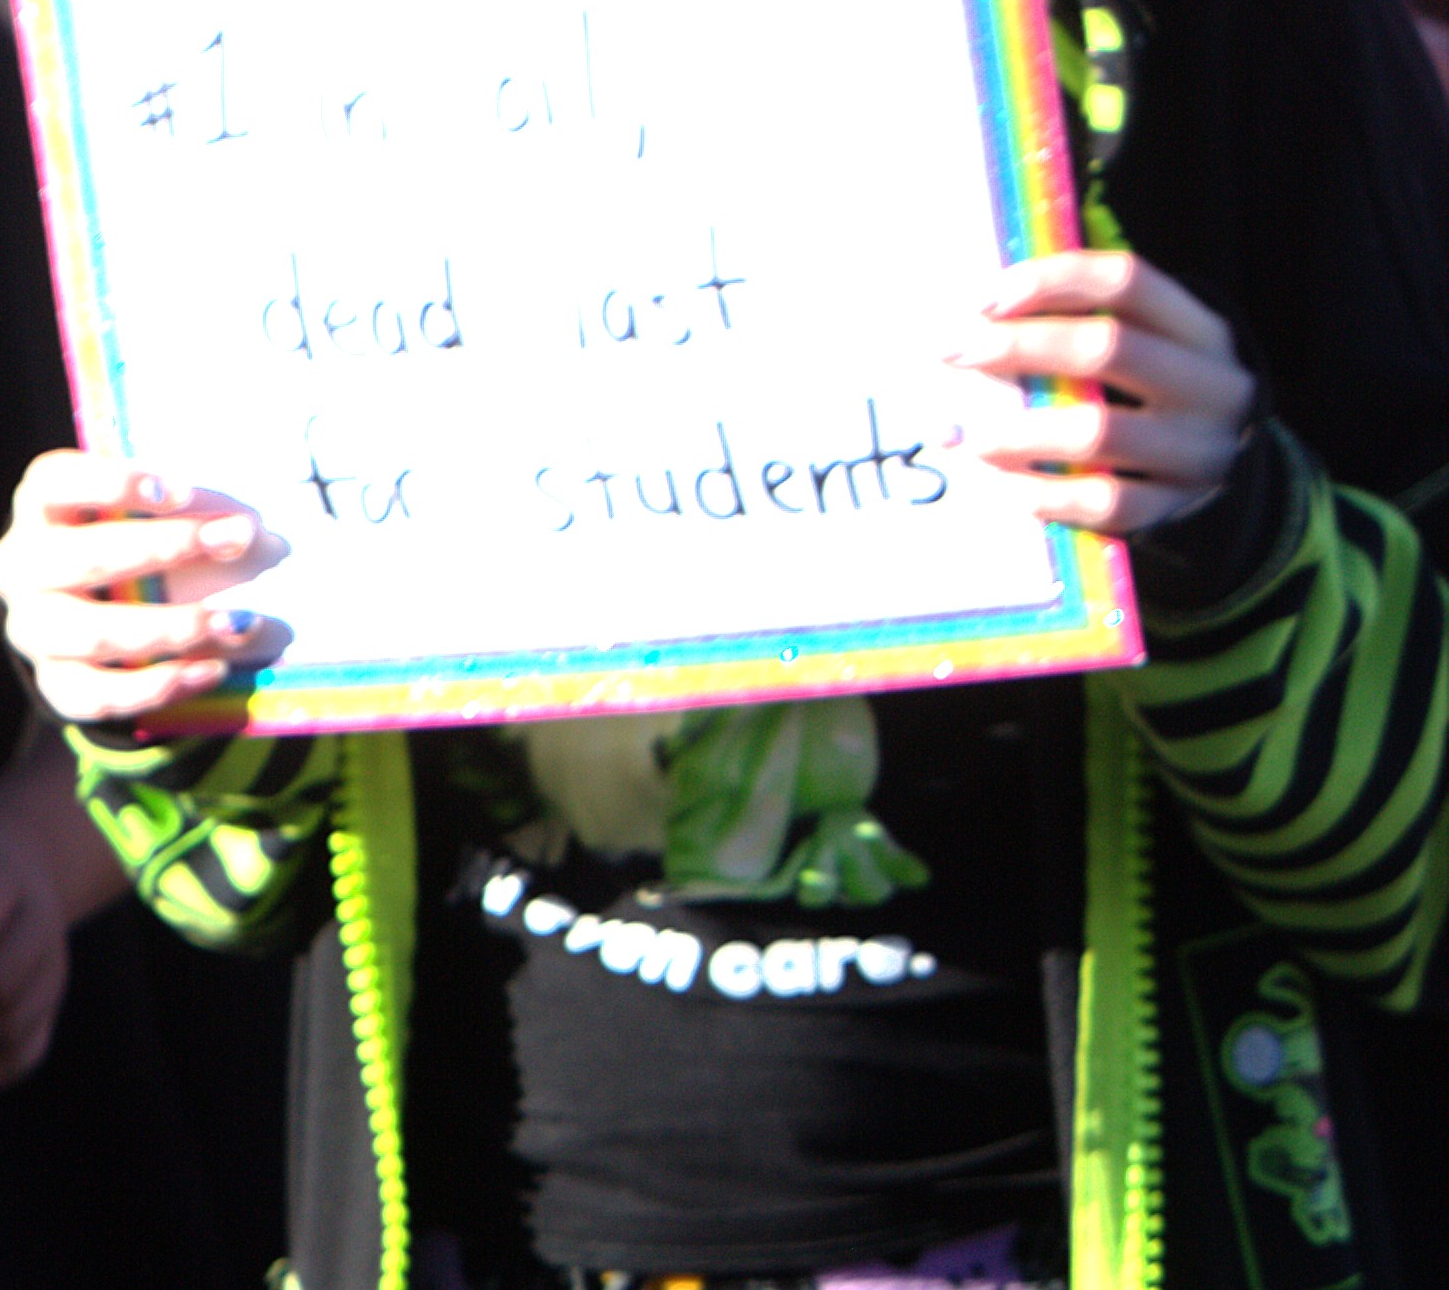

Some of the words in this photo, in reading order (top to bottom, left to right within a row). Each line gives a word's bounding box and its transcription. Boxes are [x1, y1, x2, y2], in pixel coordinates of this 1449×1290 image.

[132, 31, 249, 143] #1
[261, 253, 464, 360] dead
[577, 226, 747, 349] last
[535, 398, 948, 532] students
